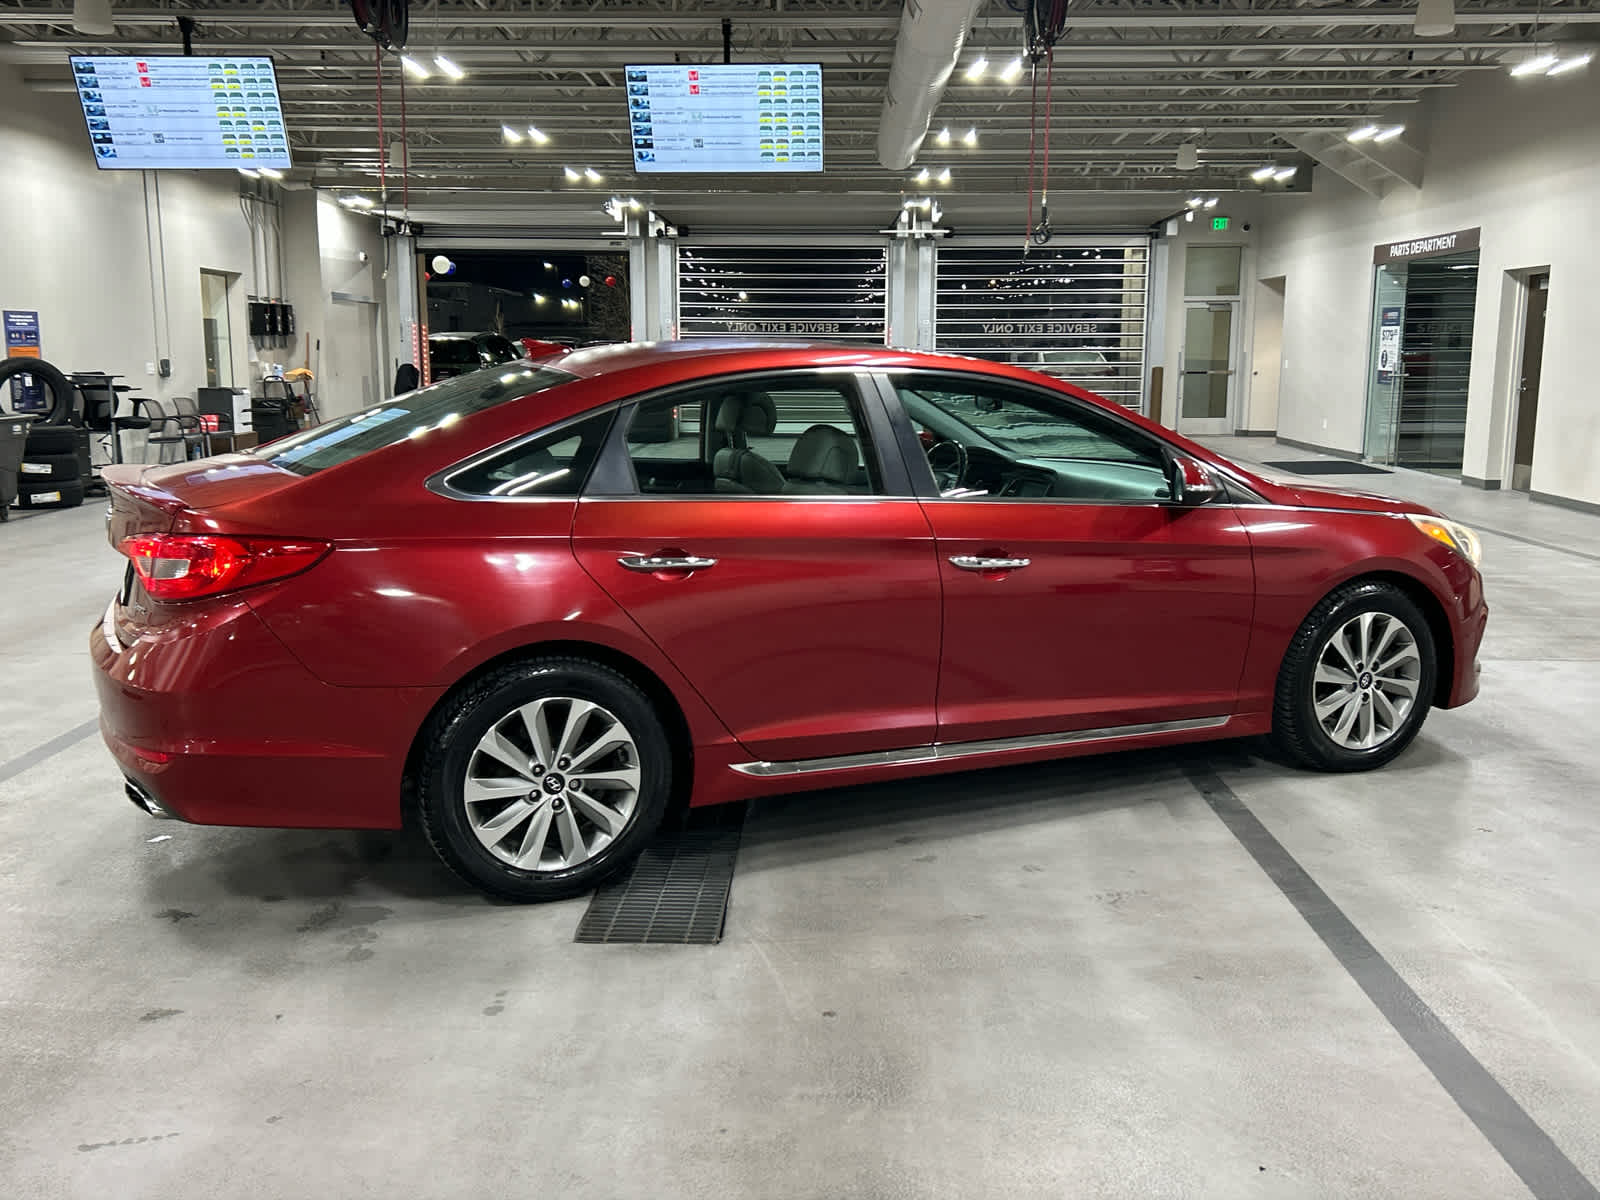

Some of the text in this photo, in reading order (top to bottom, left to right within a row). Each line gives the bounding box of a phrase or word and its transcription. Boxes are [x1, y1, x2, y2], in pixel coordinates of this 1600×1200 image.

[1213, 217, 1228, 230] EXIT
[1390, 234, 1457, 257] PARTS DEPARTMENT
